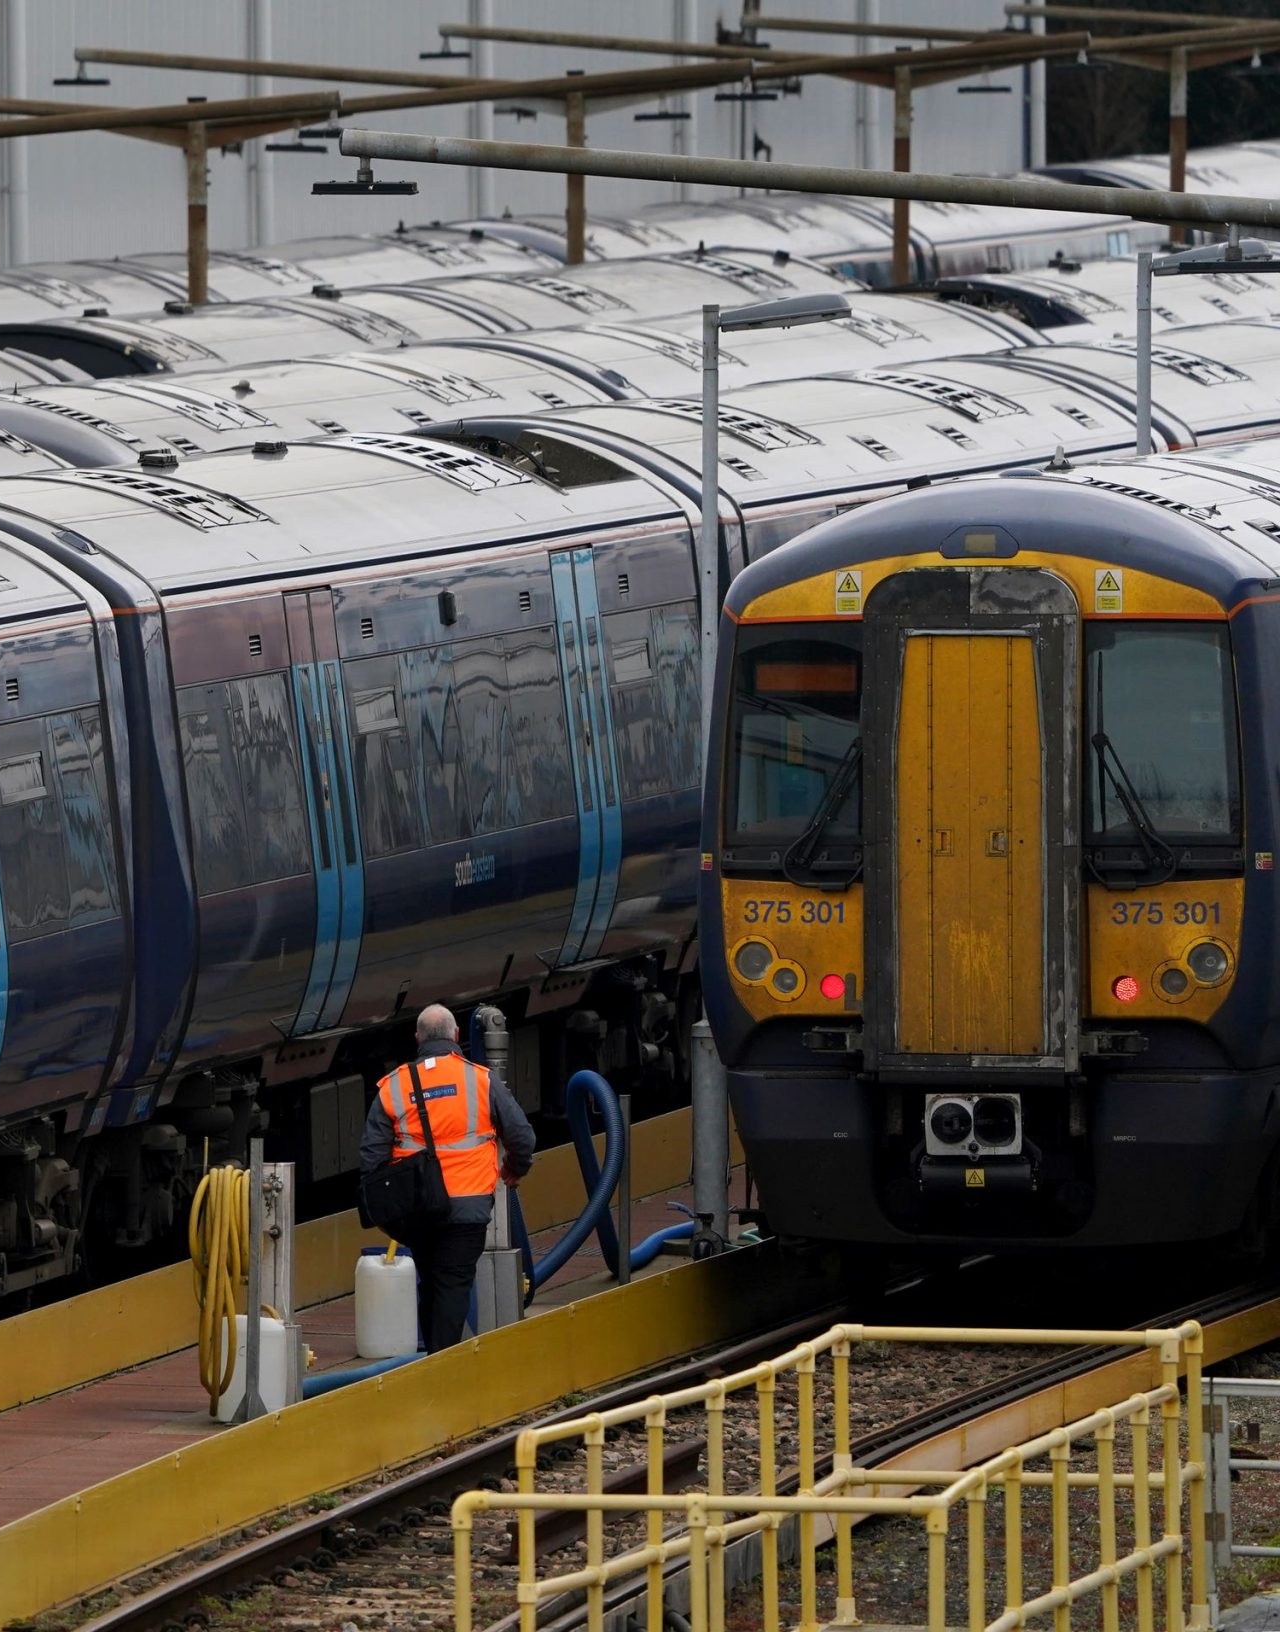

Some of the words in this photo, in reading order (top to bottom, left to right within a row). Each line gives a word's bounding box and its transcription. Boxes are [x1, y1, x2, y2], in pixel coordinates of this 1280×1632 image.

[744, 900, 791, 923] 375
[800, 900, 844, 923] 301
[1111, 901, 1163, 925] 375
[1173, 901, 1220, 925] 301
